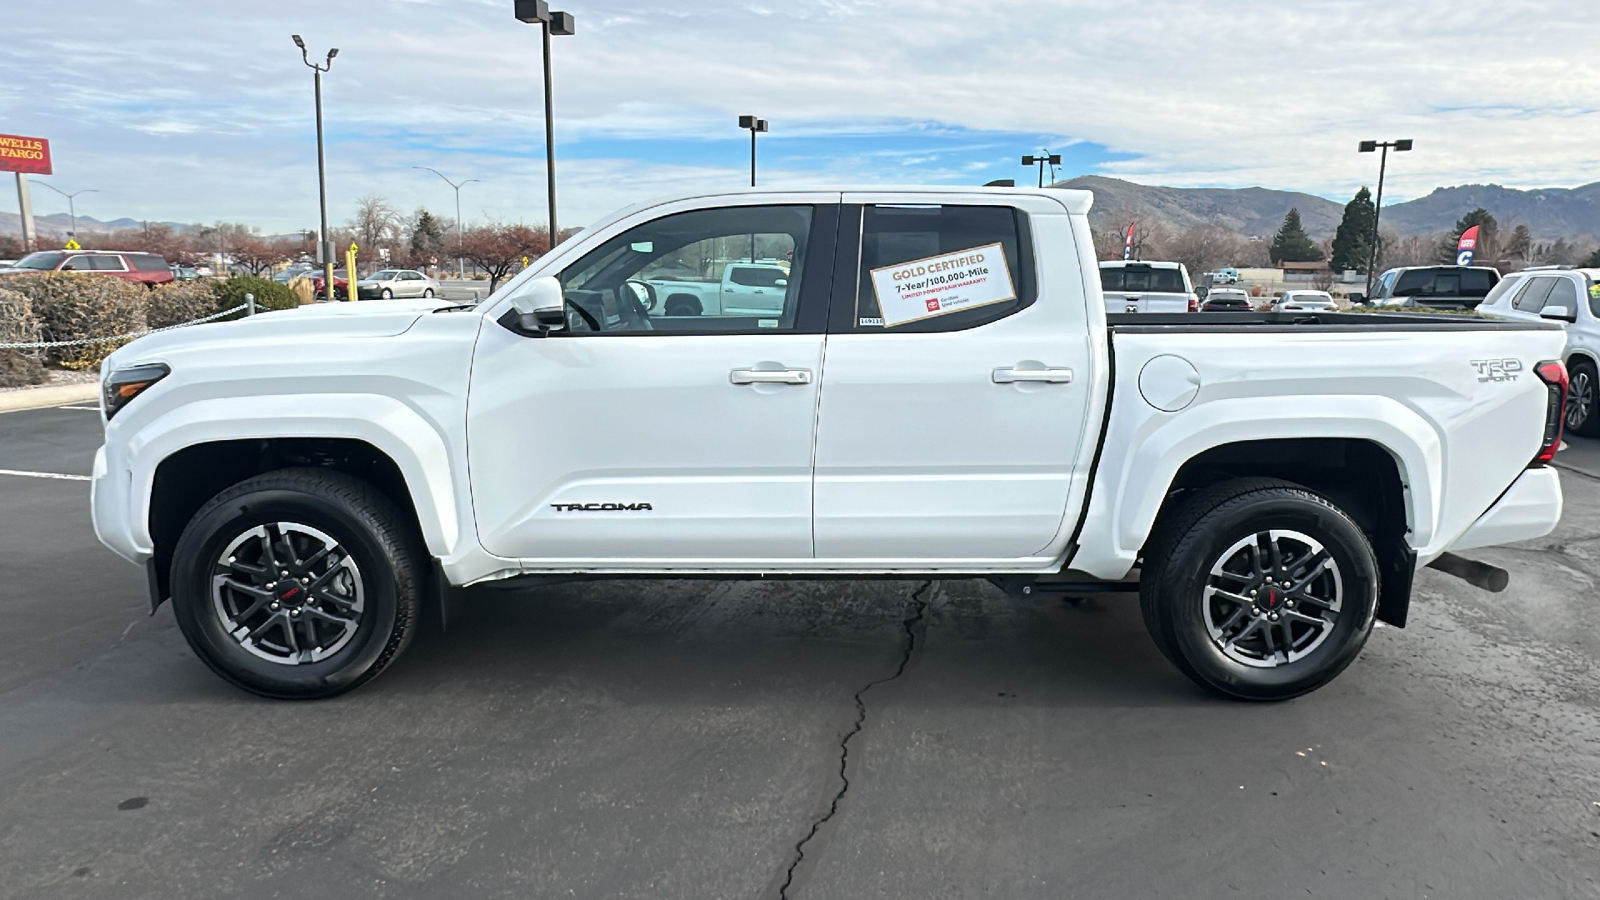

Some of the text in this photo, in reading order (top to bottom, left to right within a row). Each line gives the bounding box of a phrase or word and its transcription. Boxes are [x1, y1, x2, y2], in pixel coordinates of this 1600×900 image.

[0, 137, 43, 150] WELLS
[0, 147, 43, 160] FARGO
[892, 254, 985, 281] GOLD CERTIFIED
[895, 267, 989, 293] 7-Year/100,000-Mile
[901, 277, 987, 301] LIMITED POWERTRAIN WARRANTY
[1470, 358, 1522, 376] TRD
[1478, 374, 1518, 383] SPORT
[550, 503, 652, 511] TACOMA
